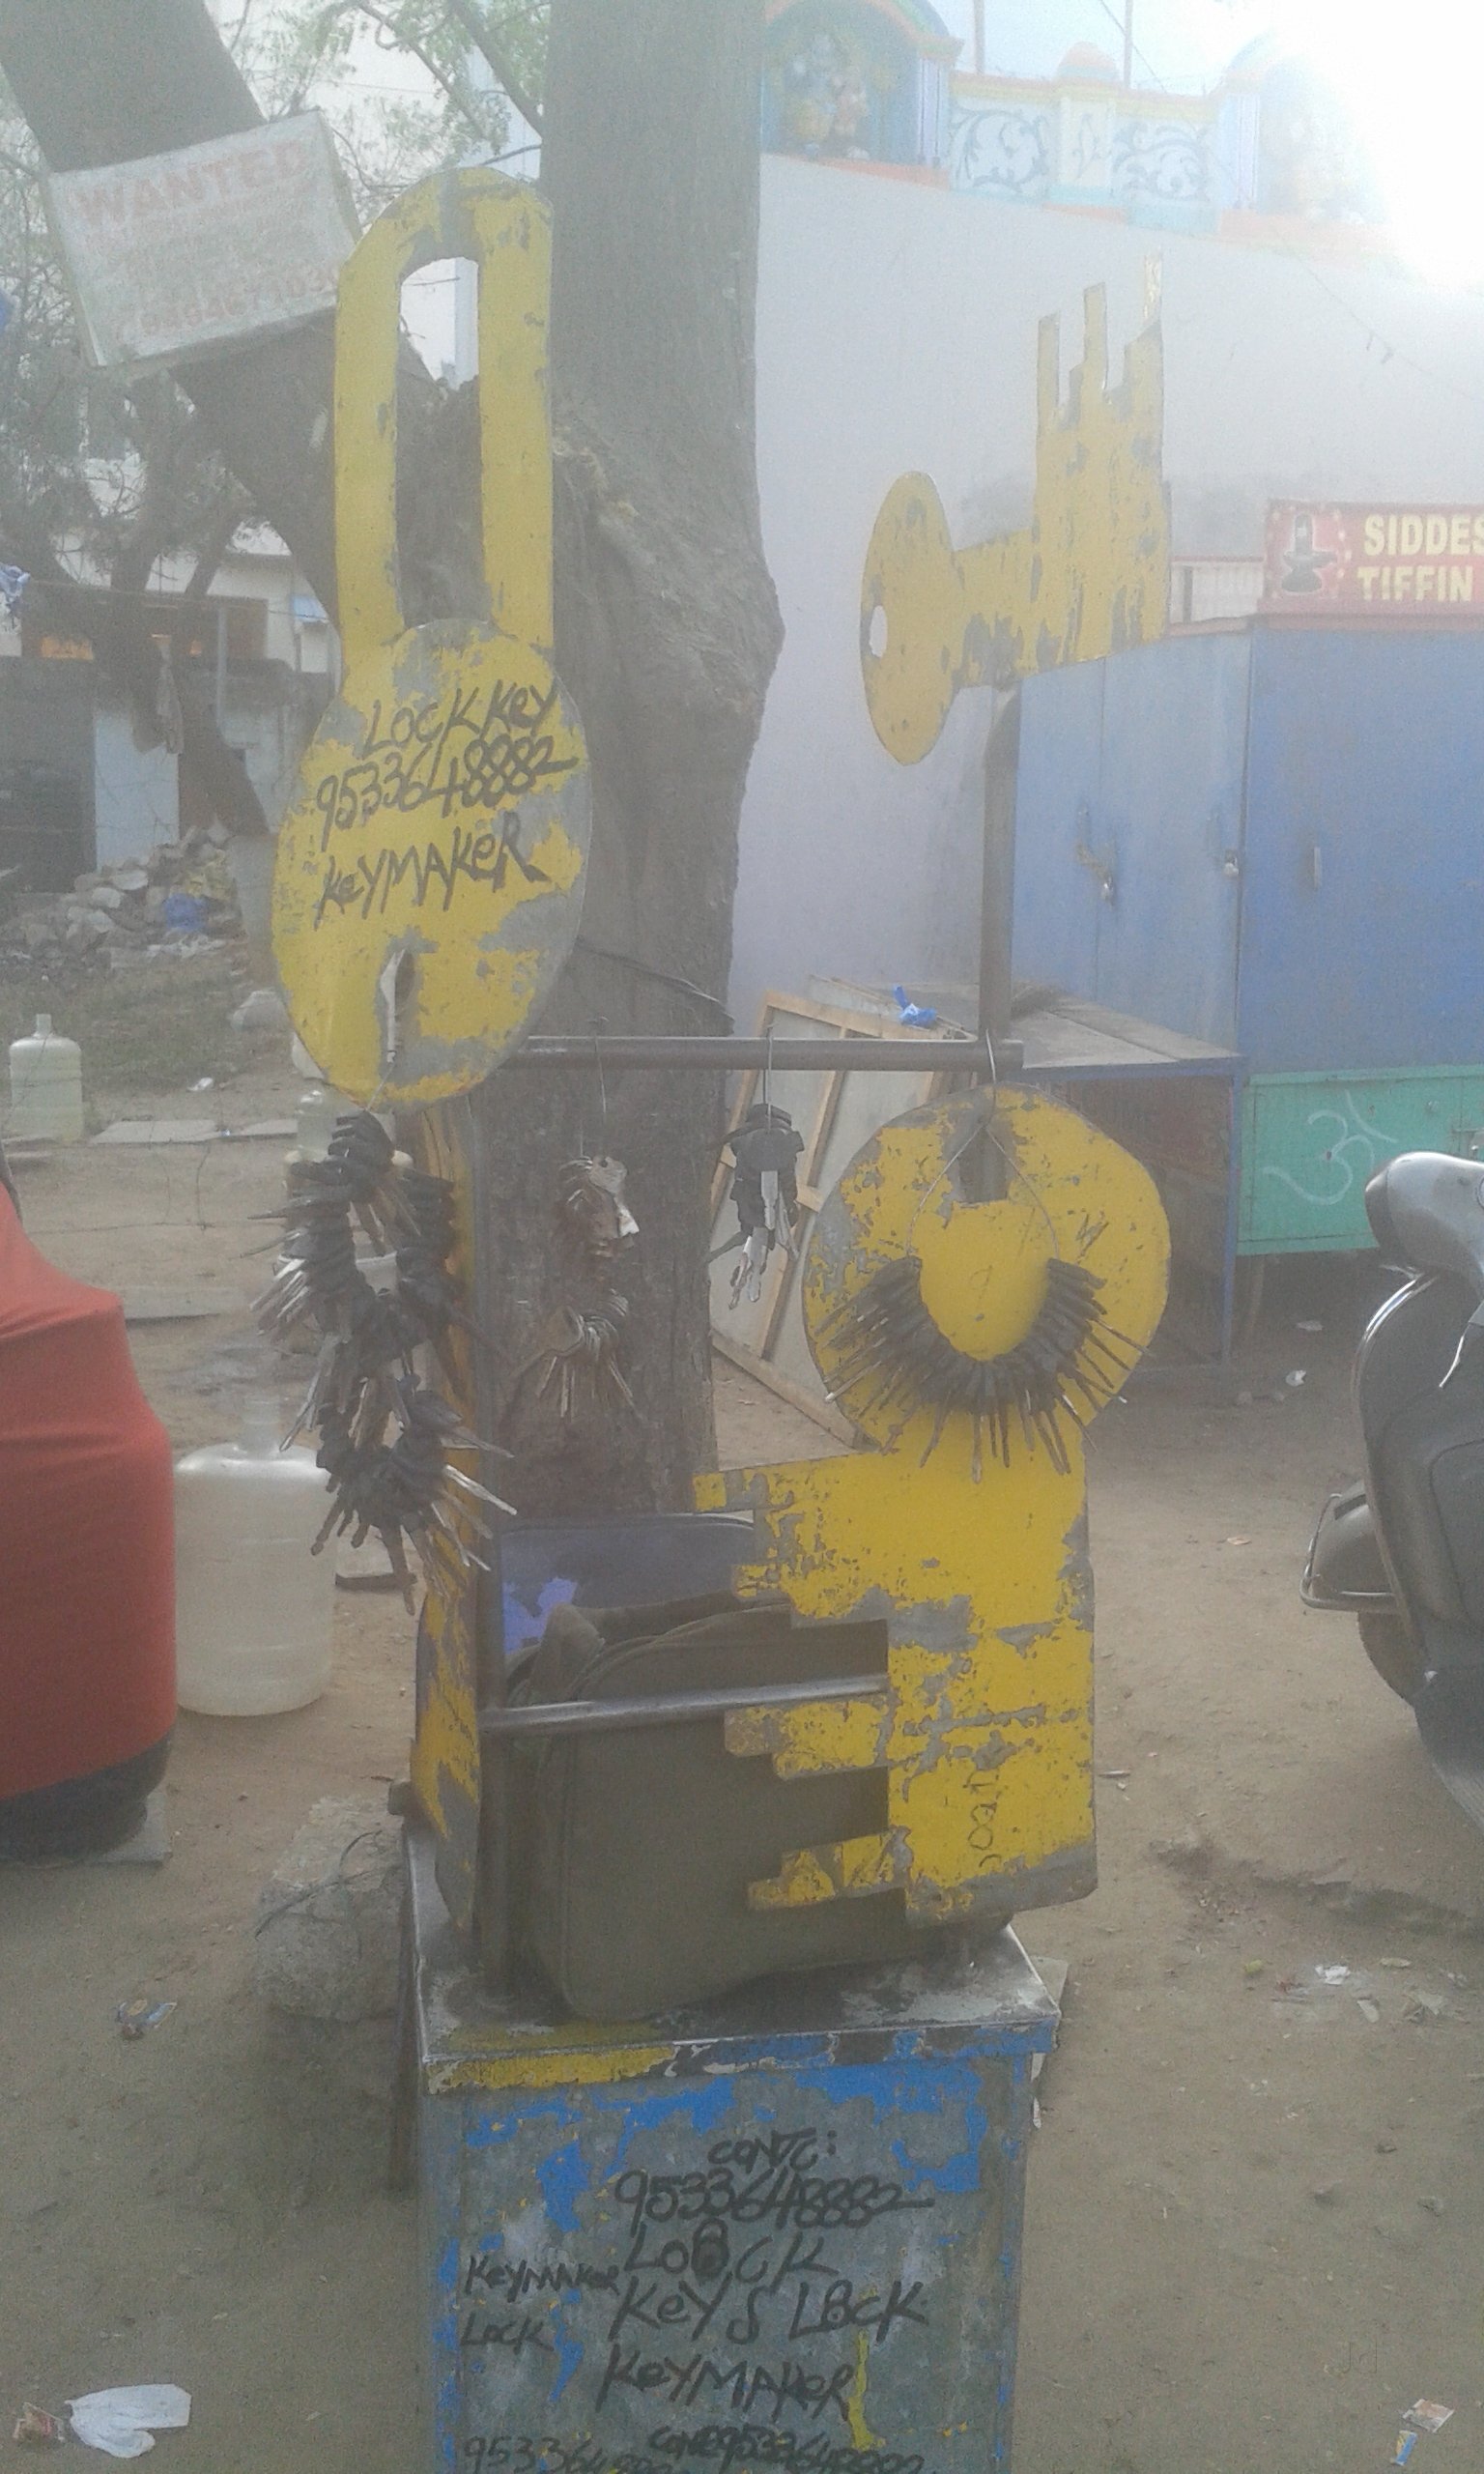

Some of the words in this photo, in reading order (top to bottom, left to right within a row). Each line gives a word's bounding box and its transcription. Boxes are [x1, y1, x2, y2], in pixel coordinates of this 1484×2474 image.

[71, 141, 308, 225] WANTED
[1357, 565, 1473, 602] TIFFIN
[357, 687, 482, 761] LOCK
